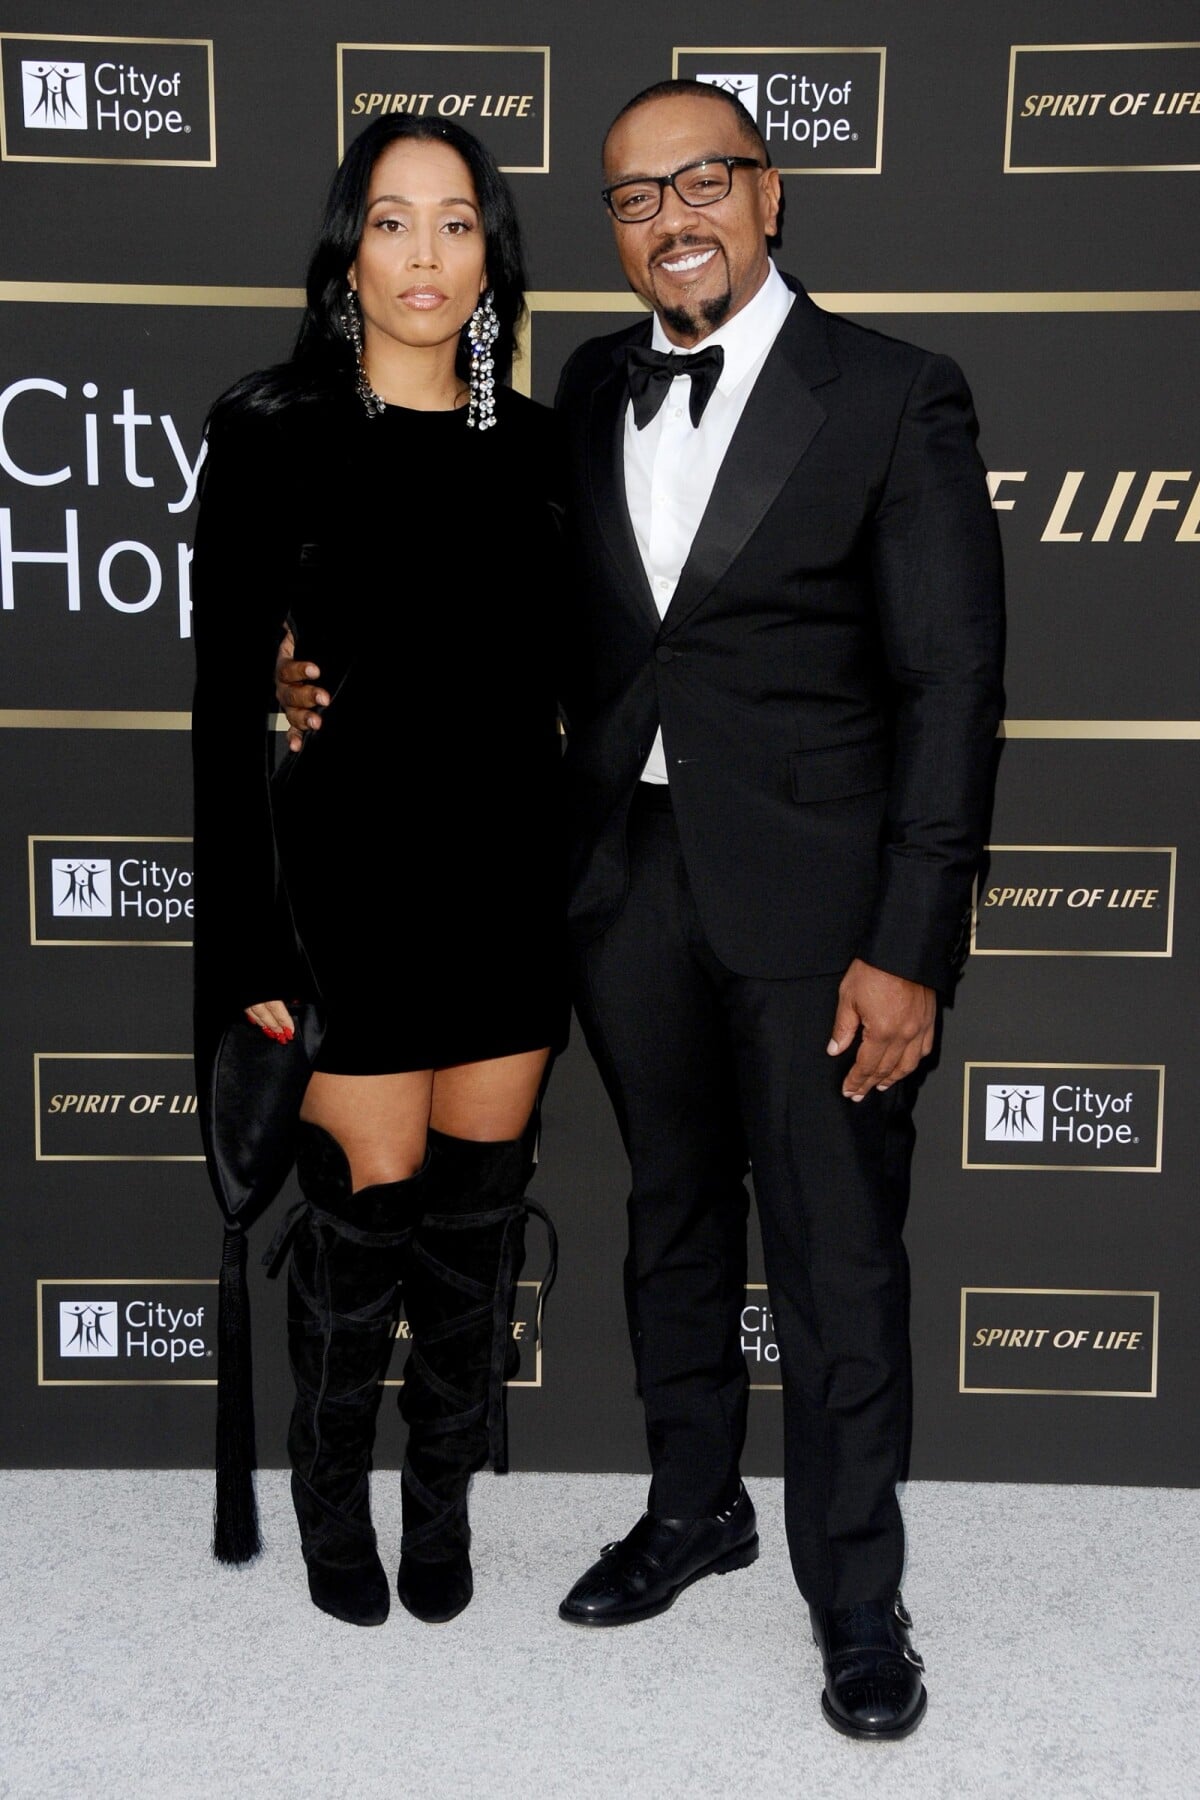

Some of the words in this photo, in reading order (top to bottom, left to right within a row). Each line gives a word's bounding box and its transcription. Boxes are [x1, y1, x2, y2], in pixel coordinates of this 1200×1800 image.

[351, 92, 435, 116] SPIRIT
[437, 94, 477, 117] OF
[479, 95, 534, 117] LIFE
[1020, 93, 1107, 117] SPIRIT
[1109, 92, 1151, 116] OF
[0, 377, 209, 514] City
[984, 887, 1064, 908] SPIRIT
[1066, 888, 1105, 908] OF
[1107, 888, 1159, 909] LIFE
[47, 1094, 126, 1113] SPIRIT
[129, 1094, 166, 1114] OF
[972, 1328, 1050, 1348] SPIRIT
[1052, 1329, 1090, 1349] OF
[1092, 1330, 1143, 1350] LIFE
